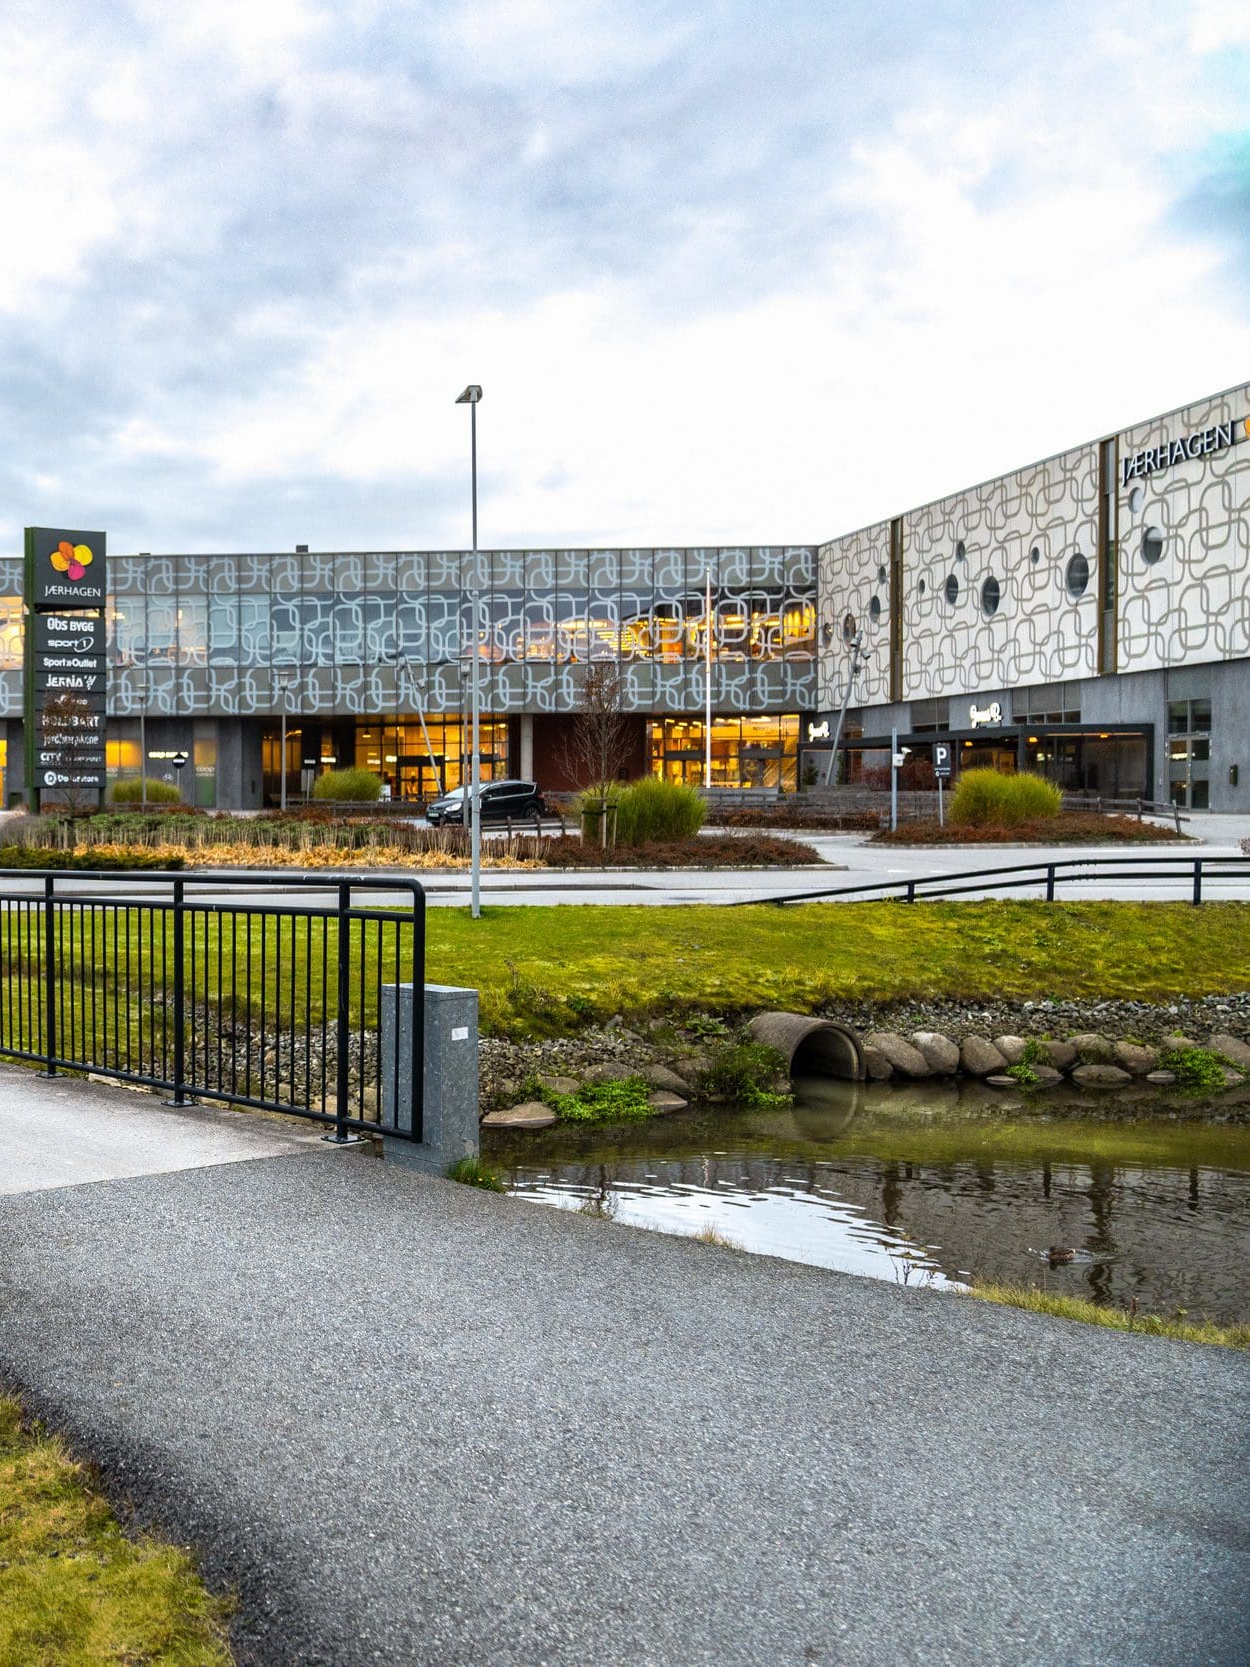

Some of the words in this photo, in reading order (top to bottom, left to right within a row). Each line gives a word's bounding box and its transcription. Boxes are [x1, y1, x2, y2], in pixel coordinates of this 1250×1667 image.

[1121, 420, 1234, 488] JÆRHAGEN
[44, 585, 101, 597] JÆRHAGEN
[69, 621, 95, 632] BYGG
[936, 747, 947, 765] P
